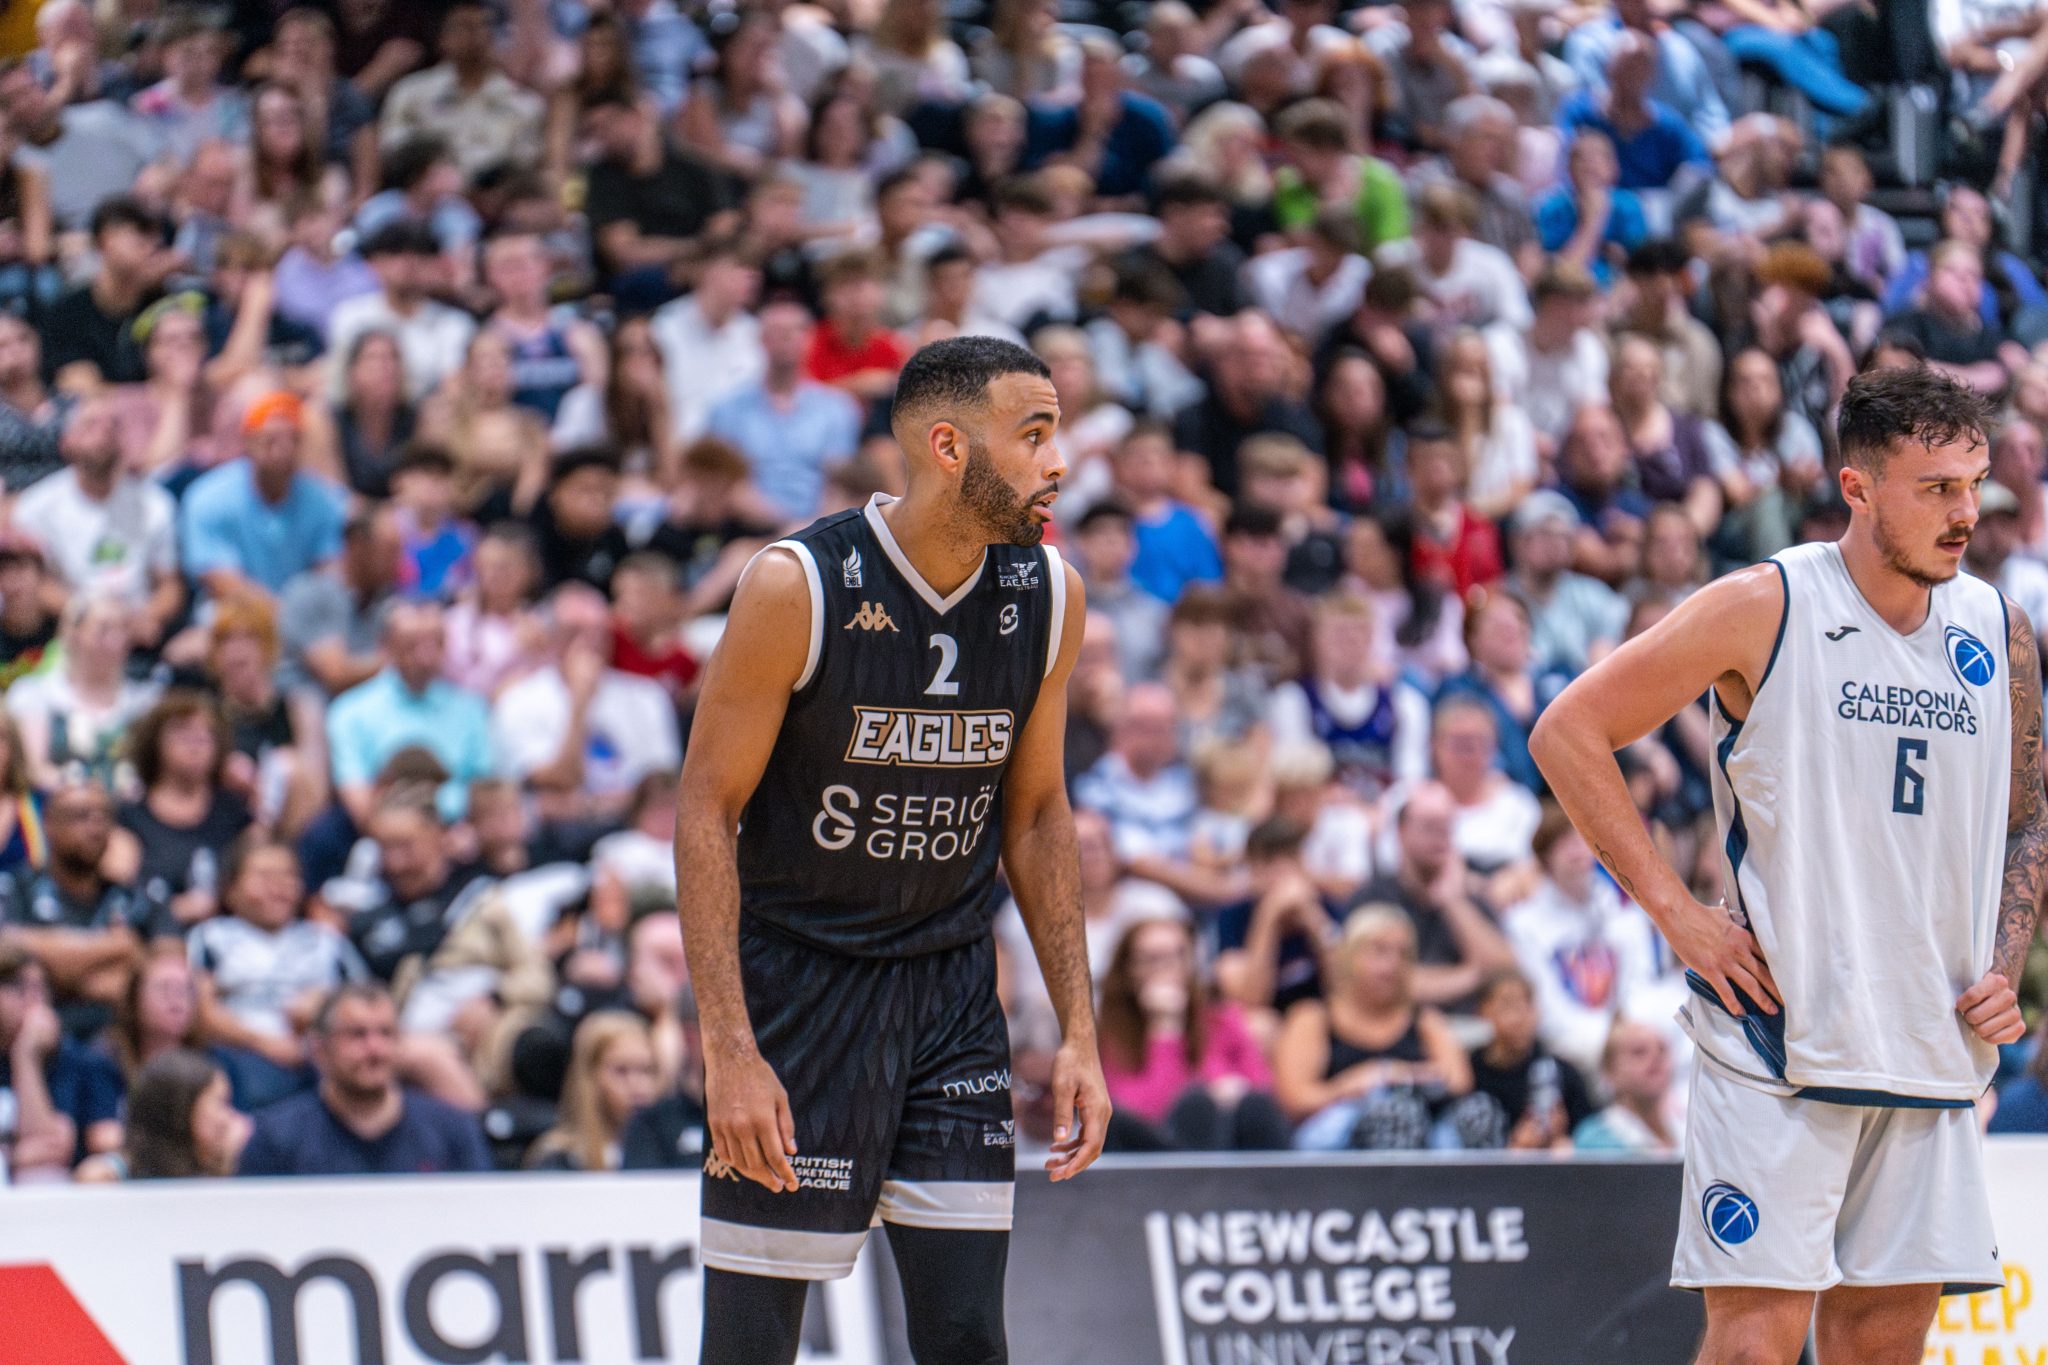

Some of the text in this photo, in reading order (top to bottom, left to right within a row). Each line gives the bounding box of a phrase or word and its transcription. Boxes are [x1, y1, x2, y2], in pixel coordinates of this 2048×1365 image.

[924, 634, 959, 695] 2
[1838, 700, 1977, 735] GLADIATORS
[1841, 681, 1972, 714] CALEDONIA
[849, 709, 1013, 764] EAGLES
[1892, 737, 1928, 815] 6
[795, 1168, 851, 1179] SKETBALL
[1173, 1207, 1529, 1266] NEWCASTLE
[1182, 1266, 1456, 1324] COLLEGE
[1189, 1327, 1517, 1365] UNIVERSITY
